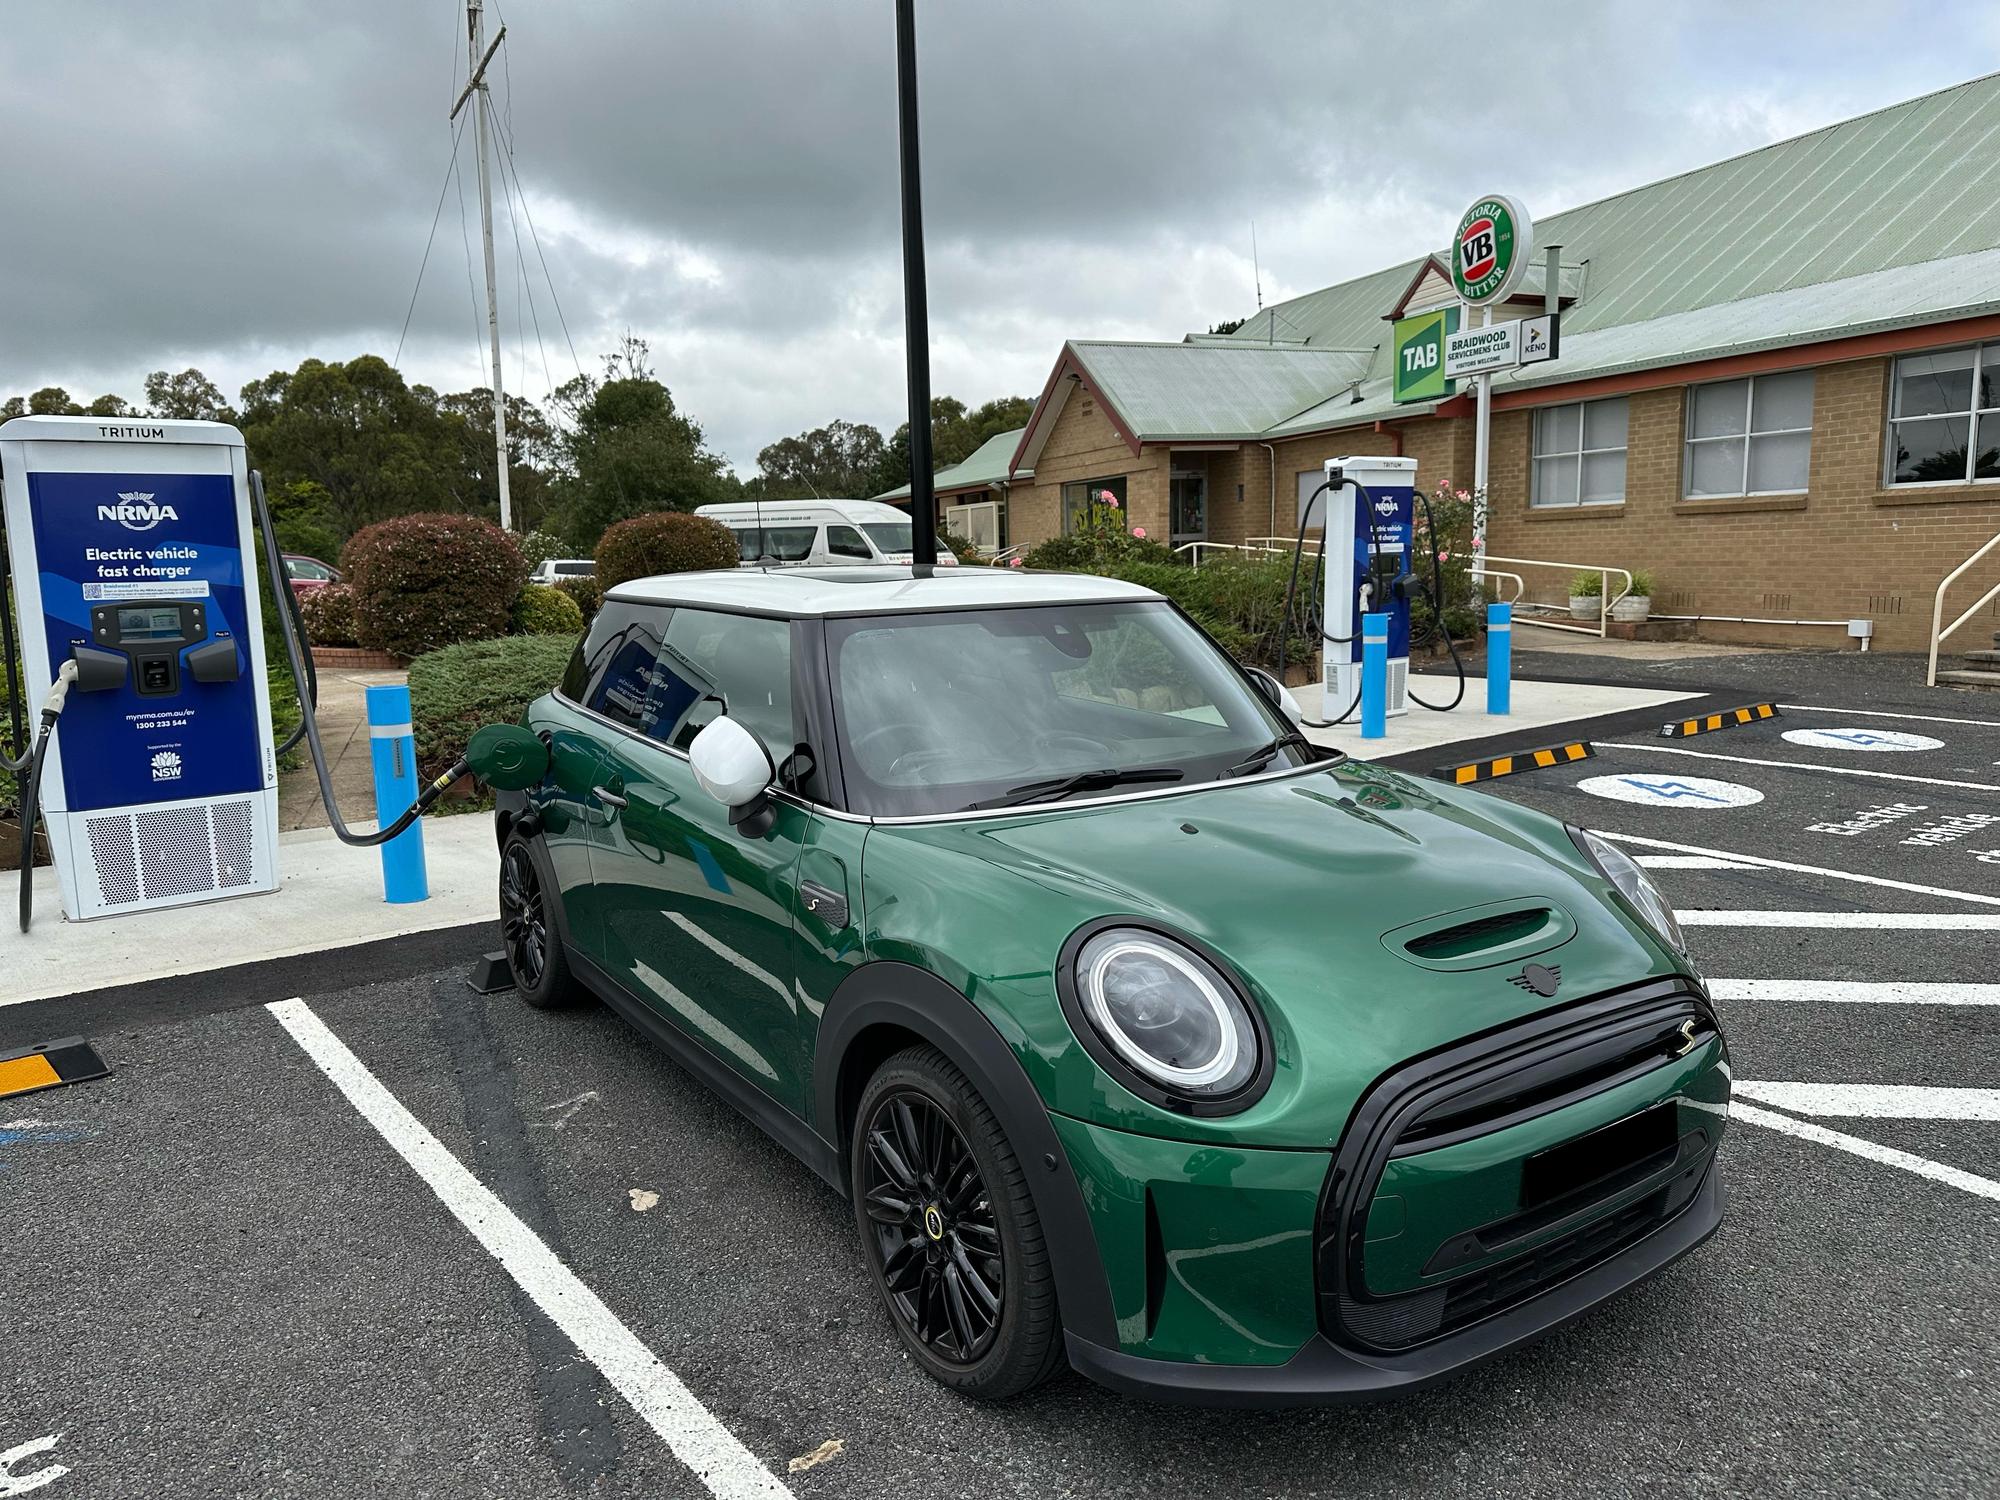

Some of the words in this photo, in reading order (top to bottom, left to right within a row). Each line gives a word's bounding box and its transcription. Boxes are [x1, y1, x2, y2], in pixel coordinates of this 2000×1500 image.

[1457, 204, 1502, 240] VICTORIA
[1461, 232, 1493, 267] VB
[1464, 266, 1505, 297] BITTER
[1452, 330, 1507, 351] BRAIDWOOD
[1447, 347, 1491, 361] SERVICEMENS
[1492, 341, 1511, 352] CLUB
[1524, 342, 1547, 354] KENO
[1403, 343, 1437, 372] TAB
[1455, 360, 1476, 369] VISITORS
[1477, 355, 1501, 366] WELCOME
[99, 426, 164, 439] TRITIUM
[97, 505, 179, 521] NRMA
[1375, 502, 1399, 512] NRMA
[1370, 525, 1387, 533] Ectric
[86, 548, 142, 561] Electric
[146, 547, 198, 560] vehicle
[97, 565, 129, 578] fast
[132, 564, 191, 578] charger
[125, 709, 195, 721] mynrma.com.au/ev
[136, 722, 155, 730] 1300
[156, 720, 171, 728] 233
[172, 719, 187, 727] 544
[152, 766, 182, 779] NSW
[1803, 802, 1929, 836] Electric
[807, 898, 820, 911] S
